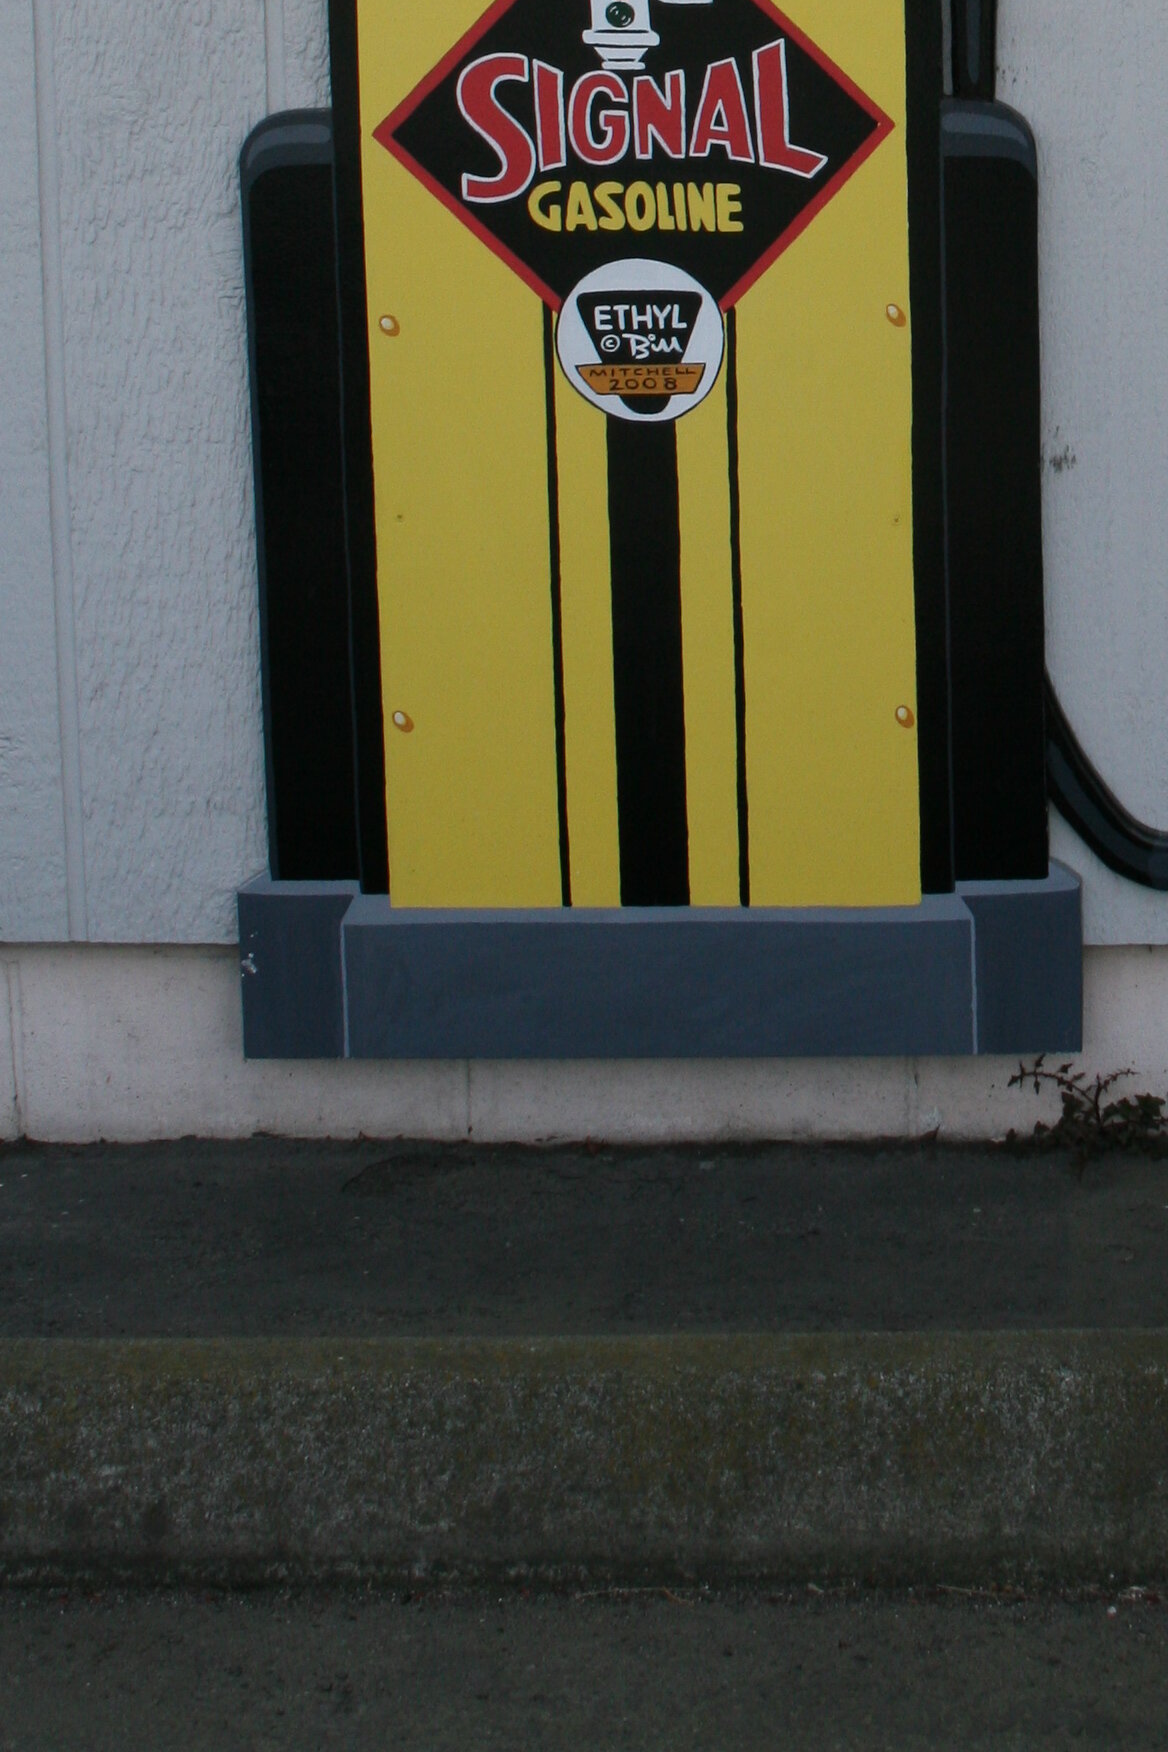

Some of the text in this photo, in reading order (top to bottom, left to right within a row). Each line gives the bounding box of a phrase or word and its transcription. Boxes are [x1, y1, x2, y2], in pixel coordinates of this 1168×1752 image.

[456, 38, 829, 204] SIGNAL
[528, 180, 744, 233] GASOLINE
[594, 304, 688, 331] ETHYL
[589, 368, 697, 377] MITCHELL
[609, 378, 678, 391] 2008
